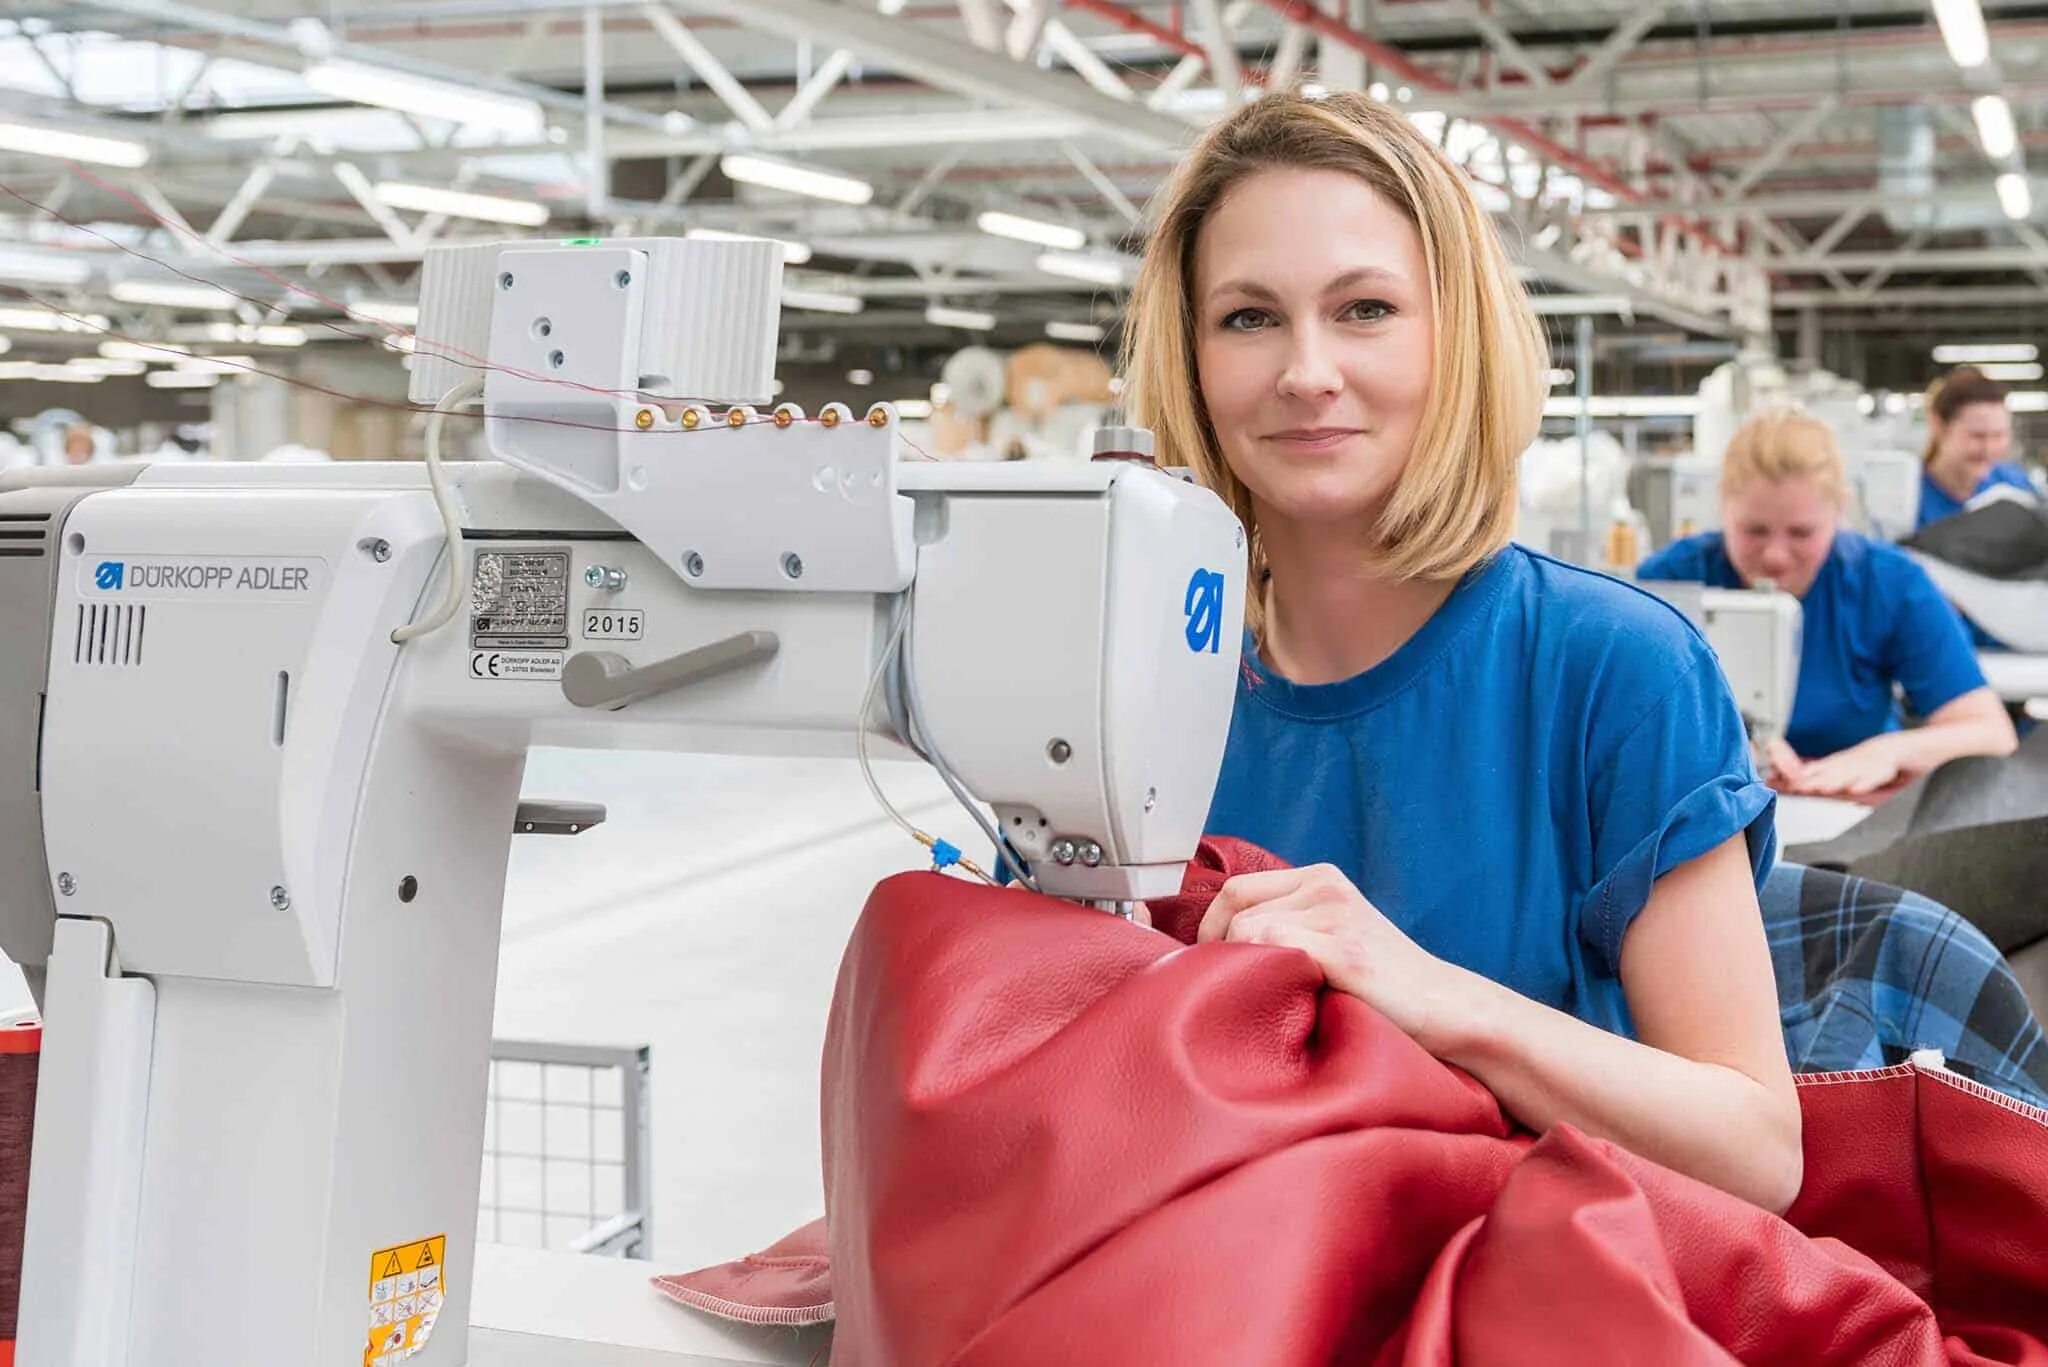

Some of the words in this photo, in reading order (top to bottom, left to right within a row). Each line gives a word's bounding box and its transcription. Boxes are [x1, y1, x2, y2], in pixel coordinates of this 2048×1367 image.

[129, 563, 233, 589] DÜRKOPP
[236, 567, 309, 590] ADLER
[588, 615, 639, 633] 2015
